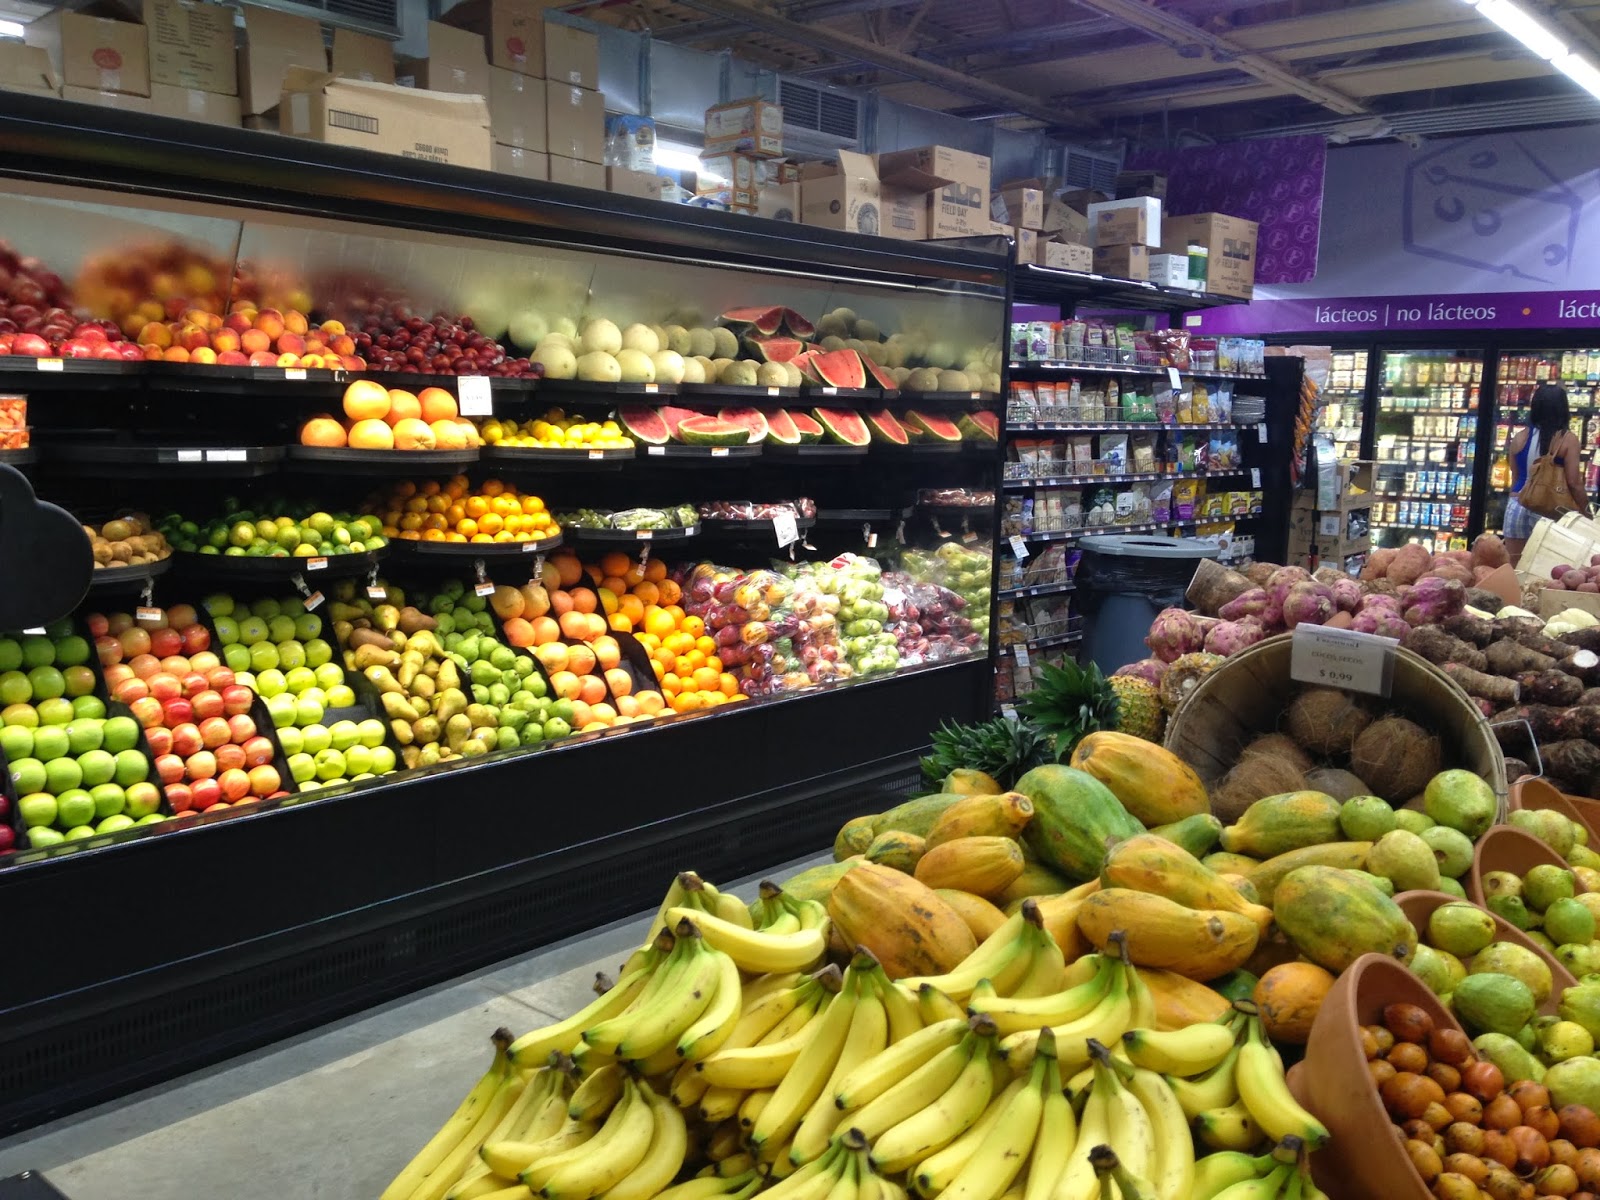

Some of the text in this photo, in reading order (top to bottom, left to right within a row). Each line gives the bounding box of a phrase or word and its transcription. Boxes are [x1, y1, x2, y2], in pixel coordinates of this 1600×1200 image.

[1315, 304, 1378, 323] lácteos
[1397, 307, 1421, 322] no
[1428, 303, 1497, 321] lácteos
[1559, 299, 1600, 318] láct
